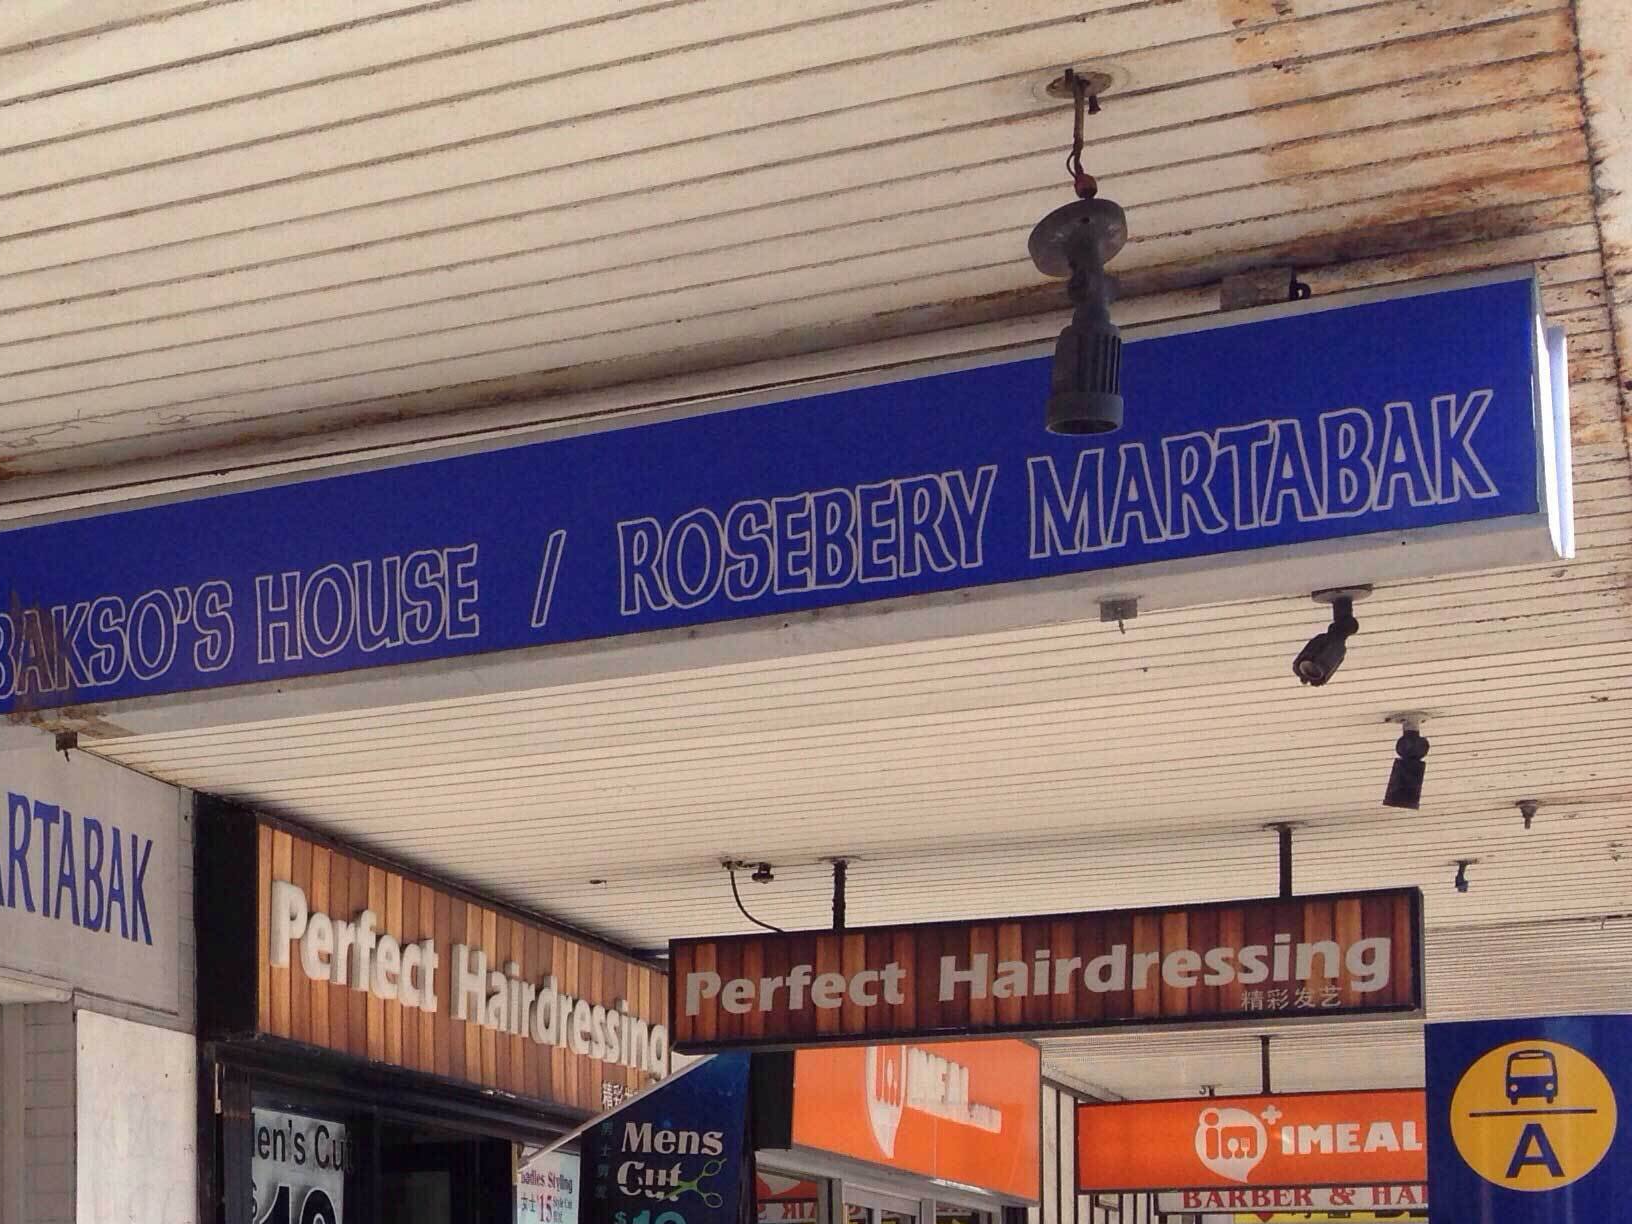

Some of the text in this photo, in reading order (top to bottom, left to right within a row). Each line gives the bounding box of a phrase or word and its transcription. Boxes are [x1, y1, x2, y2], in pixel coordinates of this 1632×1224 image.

[256, 544, 480, 664] HOUSE
[531, 530, 566, 628] /
[619, 464, 998, 616] ROSEBERY
[1027, 390, 1498, 558] MARTABAK
[270, 880, 668, 1081] Perfect Hairdressing
[685, 932, 1391, 1016] Perfect Hairdressing
[251, 1120, 305, 1165] en's
[621, 1122, 724, 1156] Mens
[1281, 1121, 1422, 1155] IMEAL
[1506, 1123, 1565, 1178] A
[618, 1161, 681, 1201] Cut
[1183, 1185, 1313, 1208] BARBER
[1372, 1184, 1427, 1204] HAI
